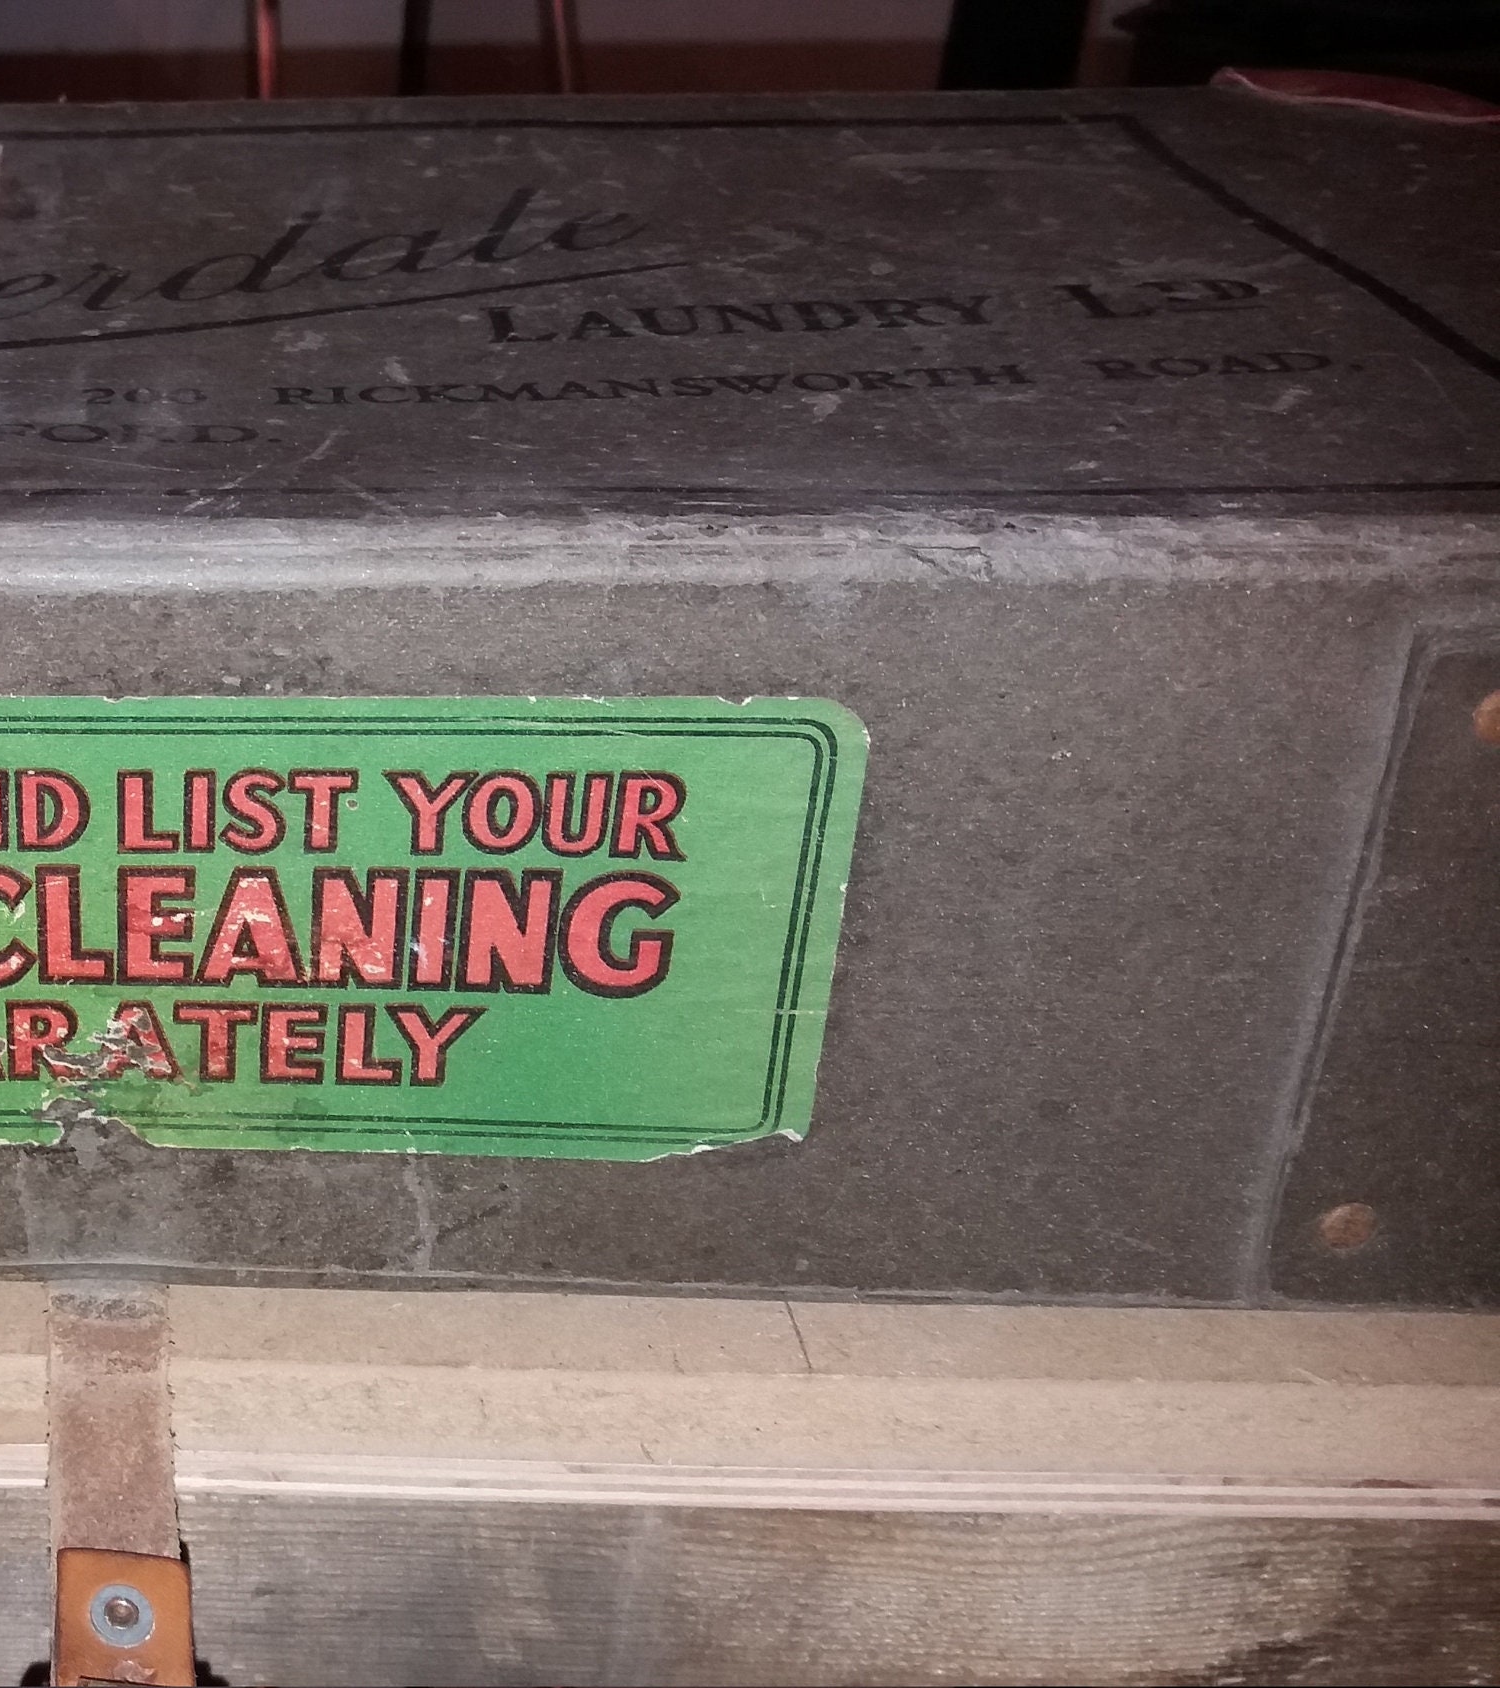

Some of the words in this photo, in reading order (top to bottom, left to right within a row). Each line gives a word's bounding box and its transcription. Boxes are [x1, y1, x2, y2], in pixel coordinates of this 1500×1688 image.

[479, 295, 994, 343] LAUNDRY
[272, 363, 1036, 405] RICKMANSWORTH
[1082, 351, 1364, 382] ROAD.
[117, 768, 359, 855] LIST
[382, 769, 688, 861] YOUR
